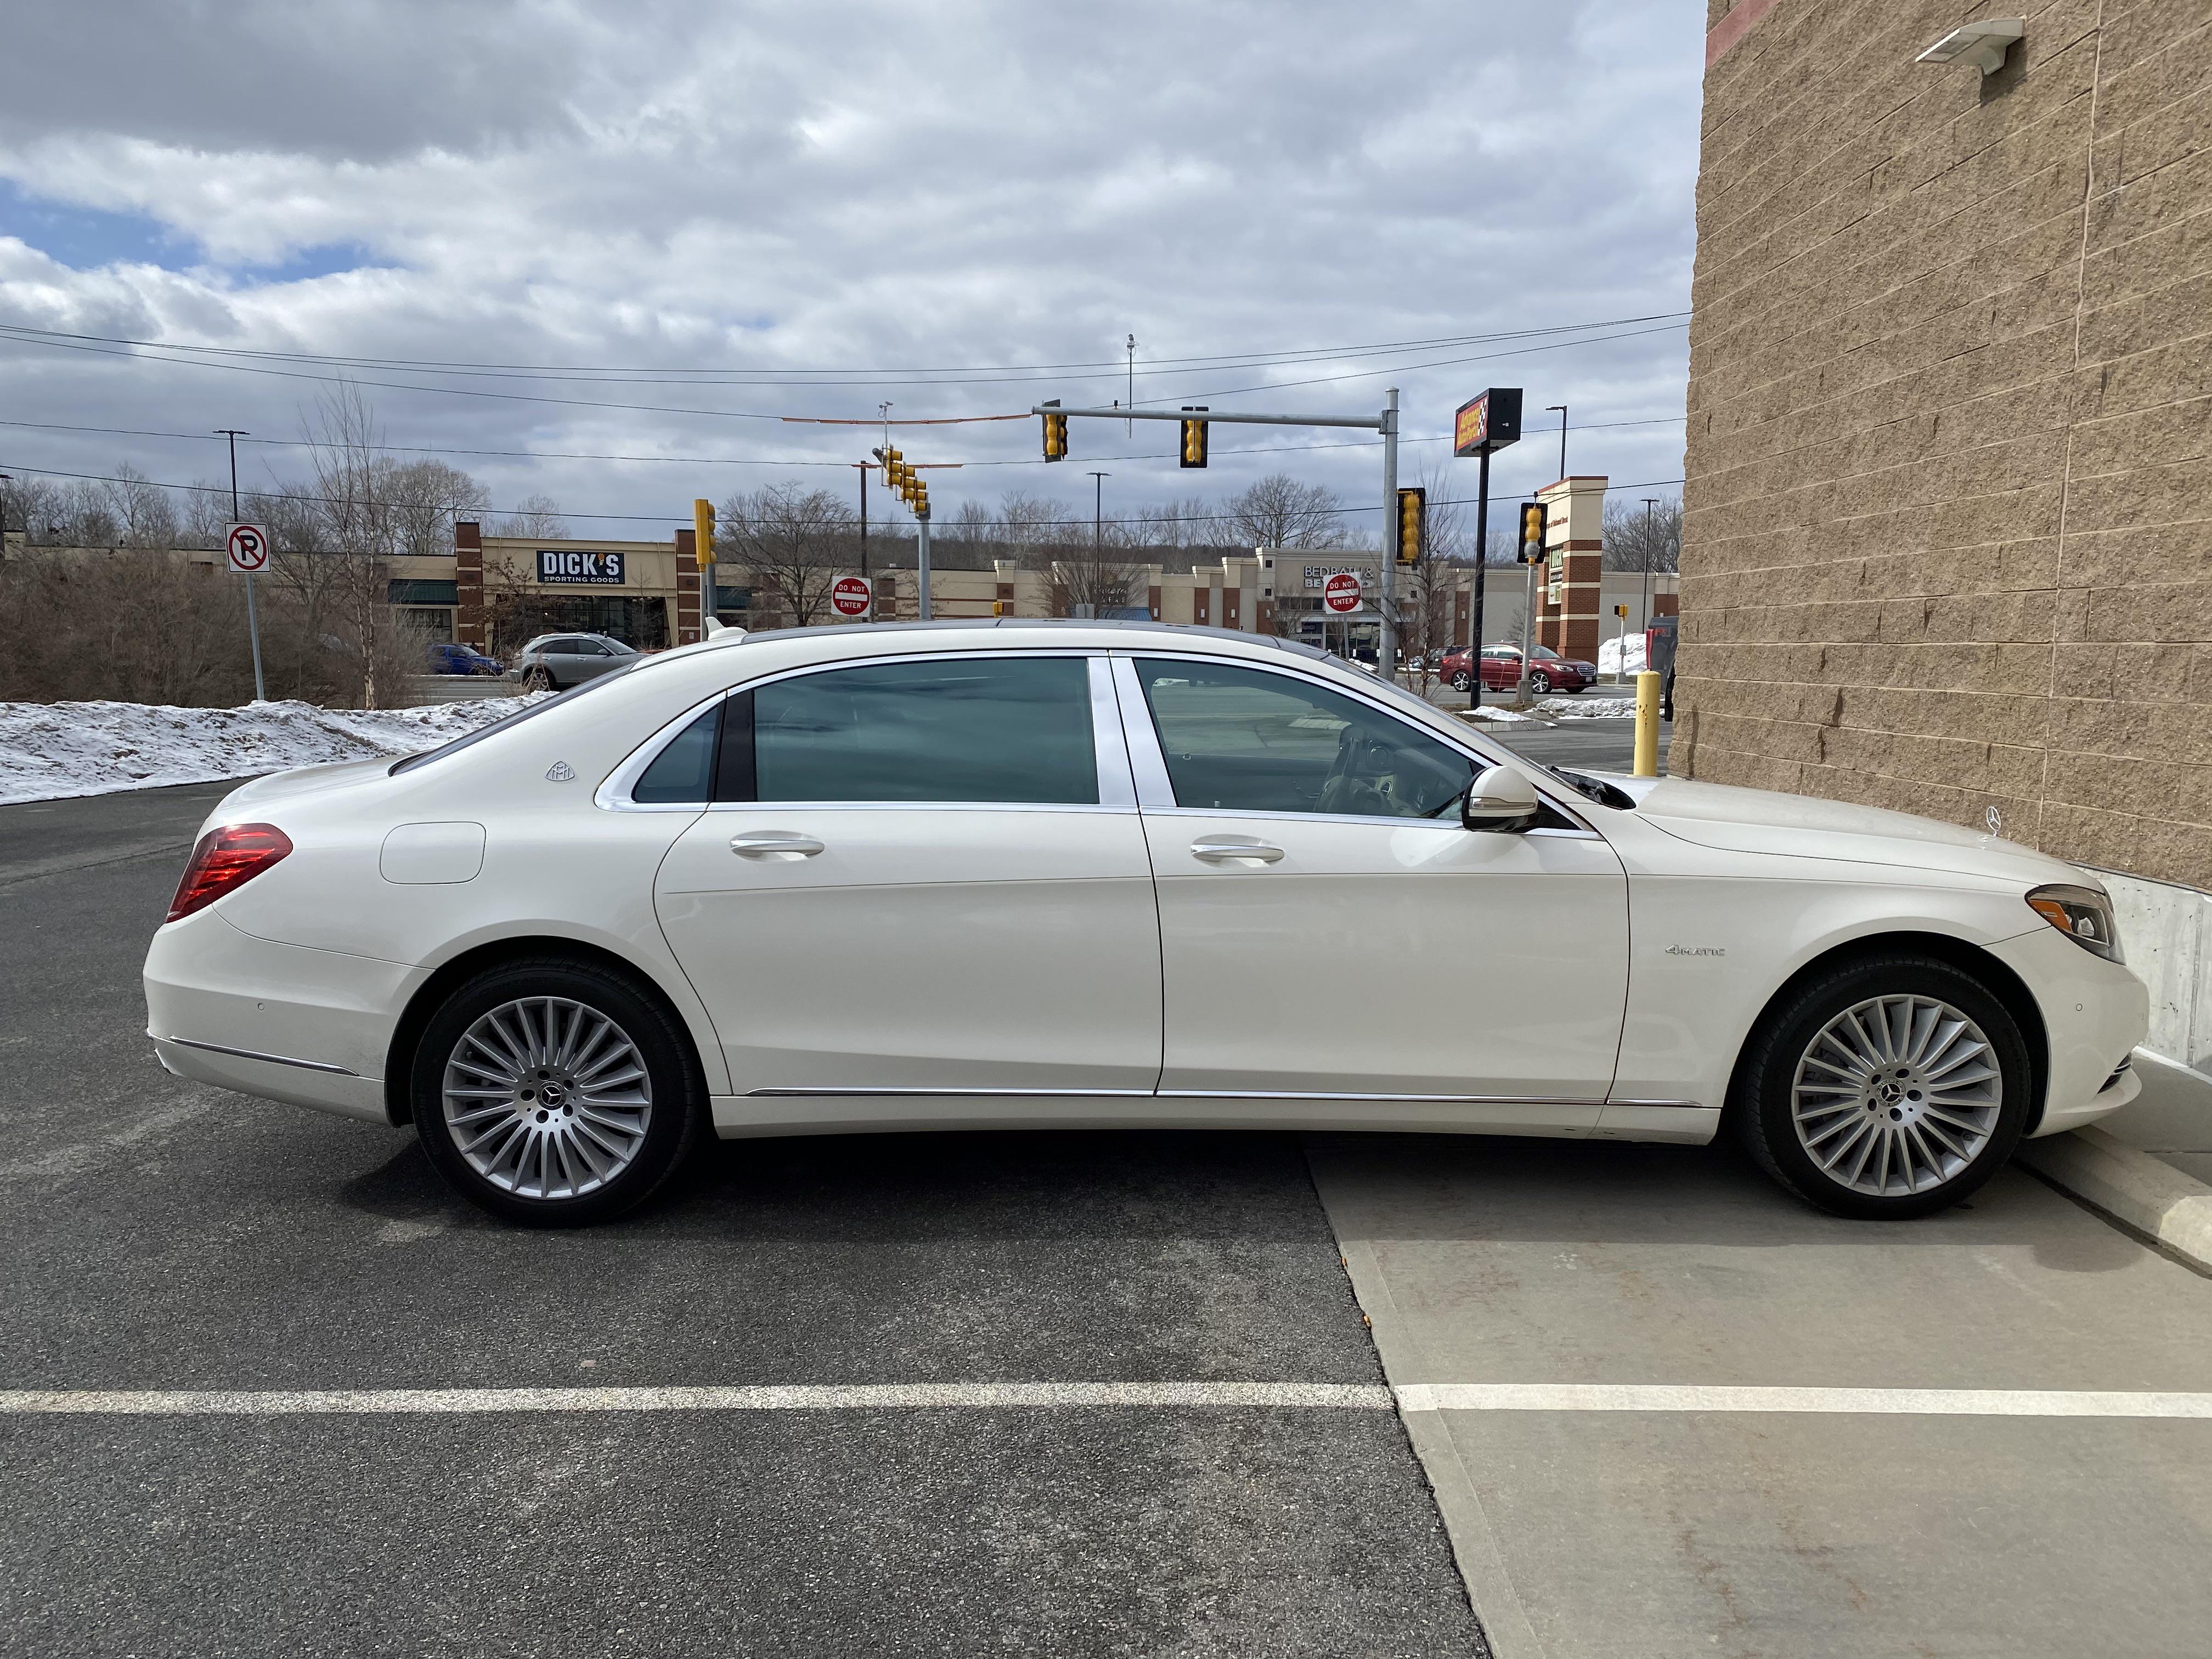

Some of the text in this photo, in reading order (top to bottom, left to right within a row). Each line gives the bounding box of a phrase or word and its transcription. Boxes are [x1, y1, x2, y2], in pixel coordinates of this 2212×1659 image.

[544, 552, 619, 575] DICK'S
[1304, 566, 1329, 577] BED
[1364, 567, 1374, 578] &
[1342, 580, 1355, 589] NOT
[1333, 597, 1353, 606] ENTER
[1665, 944, 1725, 956] 4MATIC
